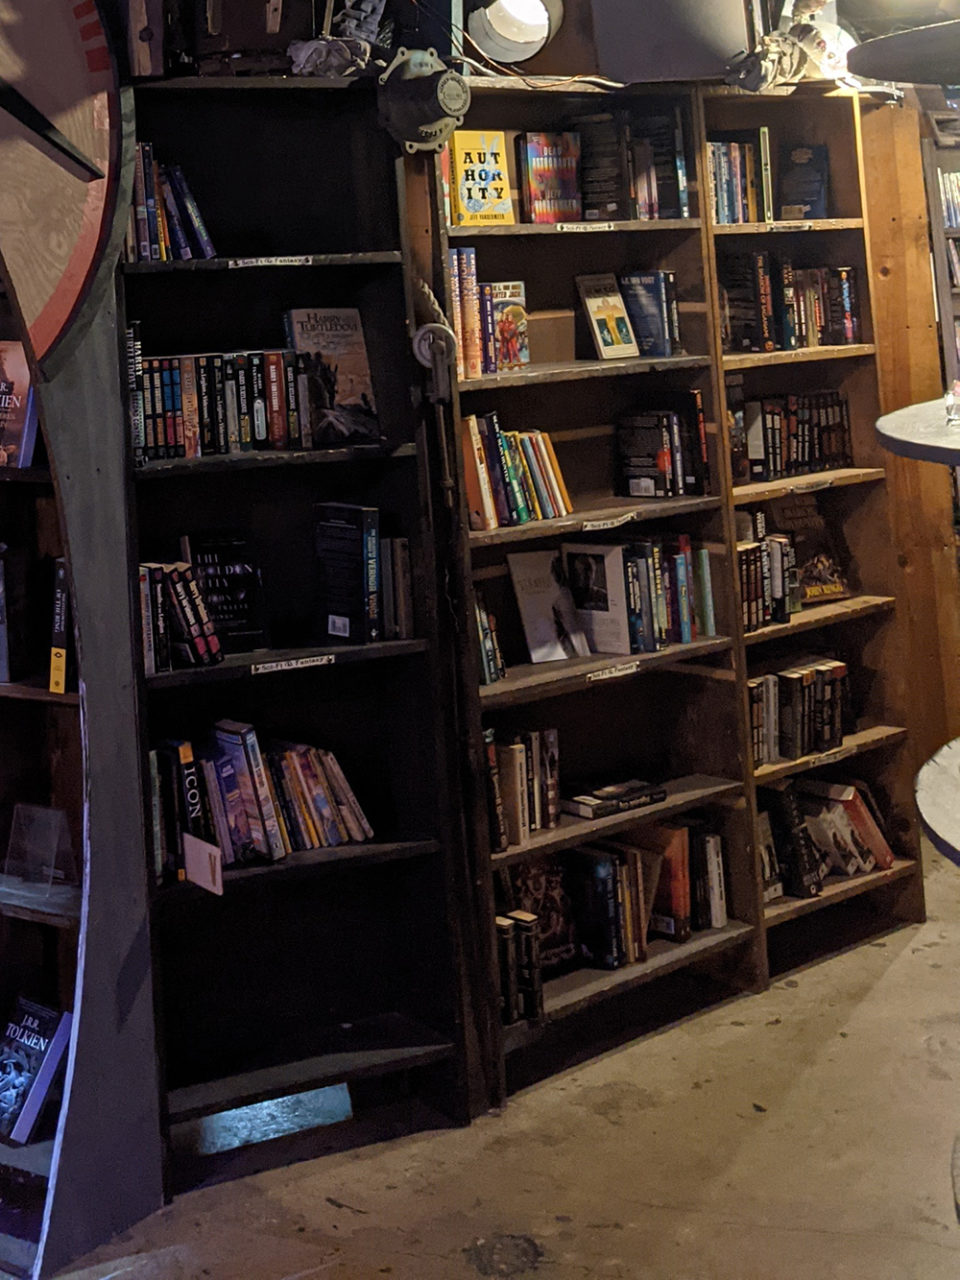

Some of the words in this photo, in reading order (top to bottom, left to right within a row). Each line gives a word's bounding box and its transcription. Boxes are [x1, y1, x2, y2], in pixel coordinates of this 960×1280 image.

[463, 152, 500, 164] AUT
[464, 169, 502, 182] HOR
[466, 187, 504, 200] ITY
[127, 328, 137, 391] TURTLEDOVE
[134, 340, 143, 377] HARRY
[368, 558, 377, 593] VERNOR
[368, 593, 378, 620] VINGE
[184, 766, 202, 819] ICON
[5, 1022, 49, 1052] TOLKIEN
